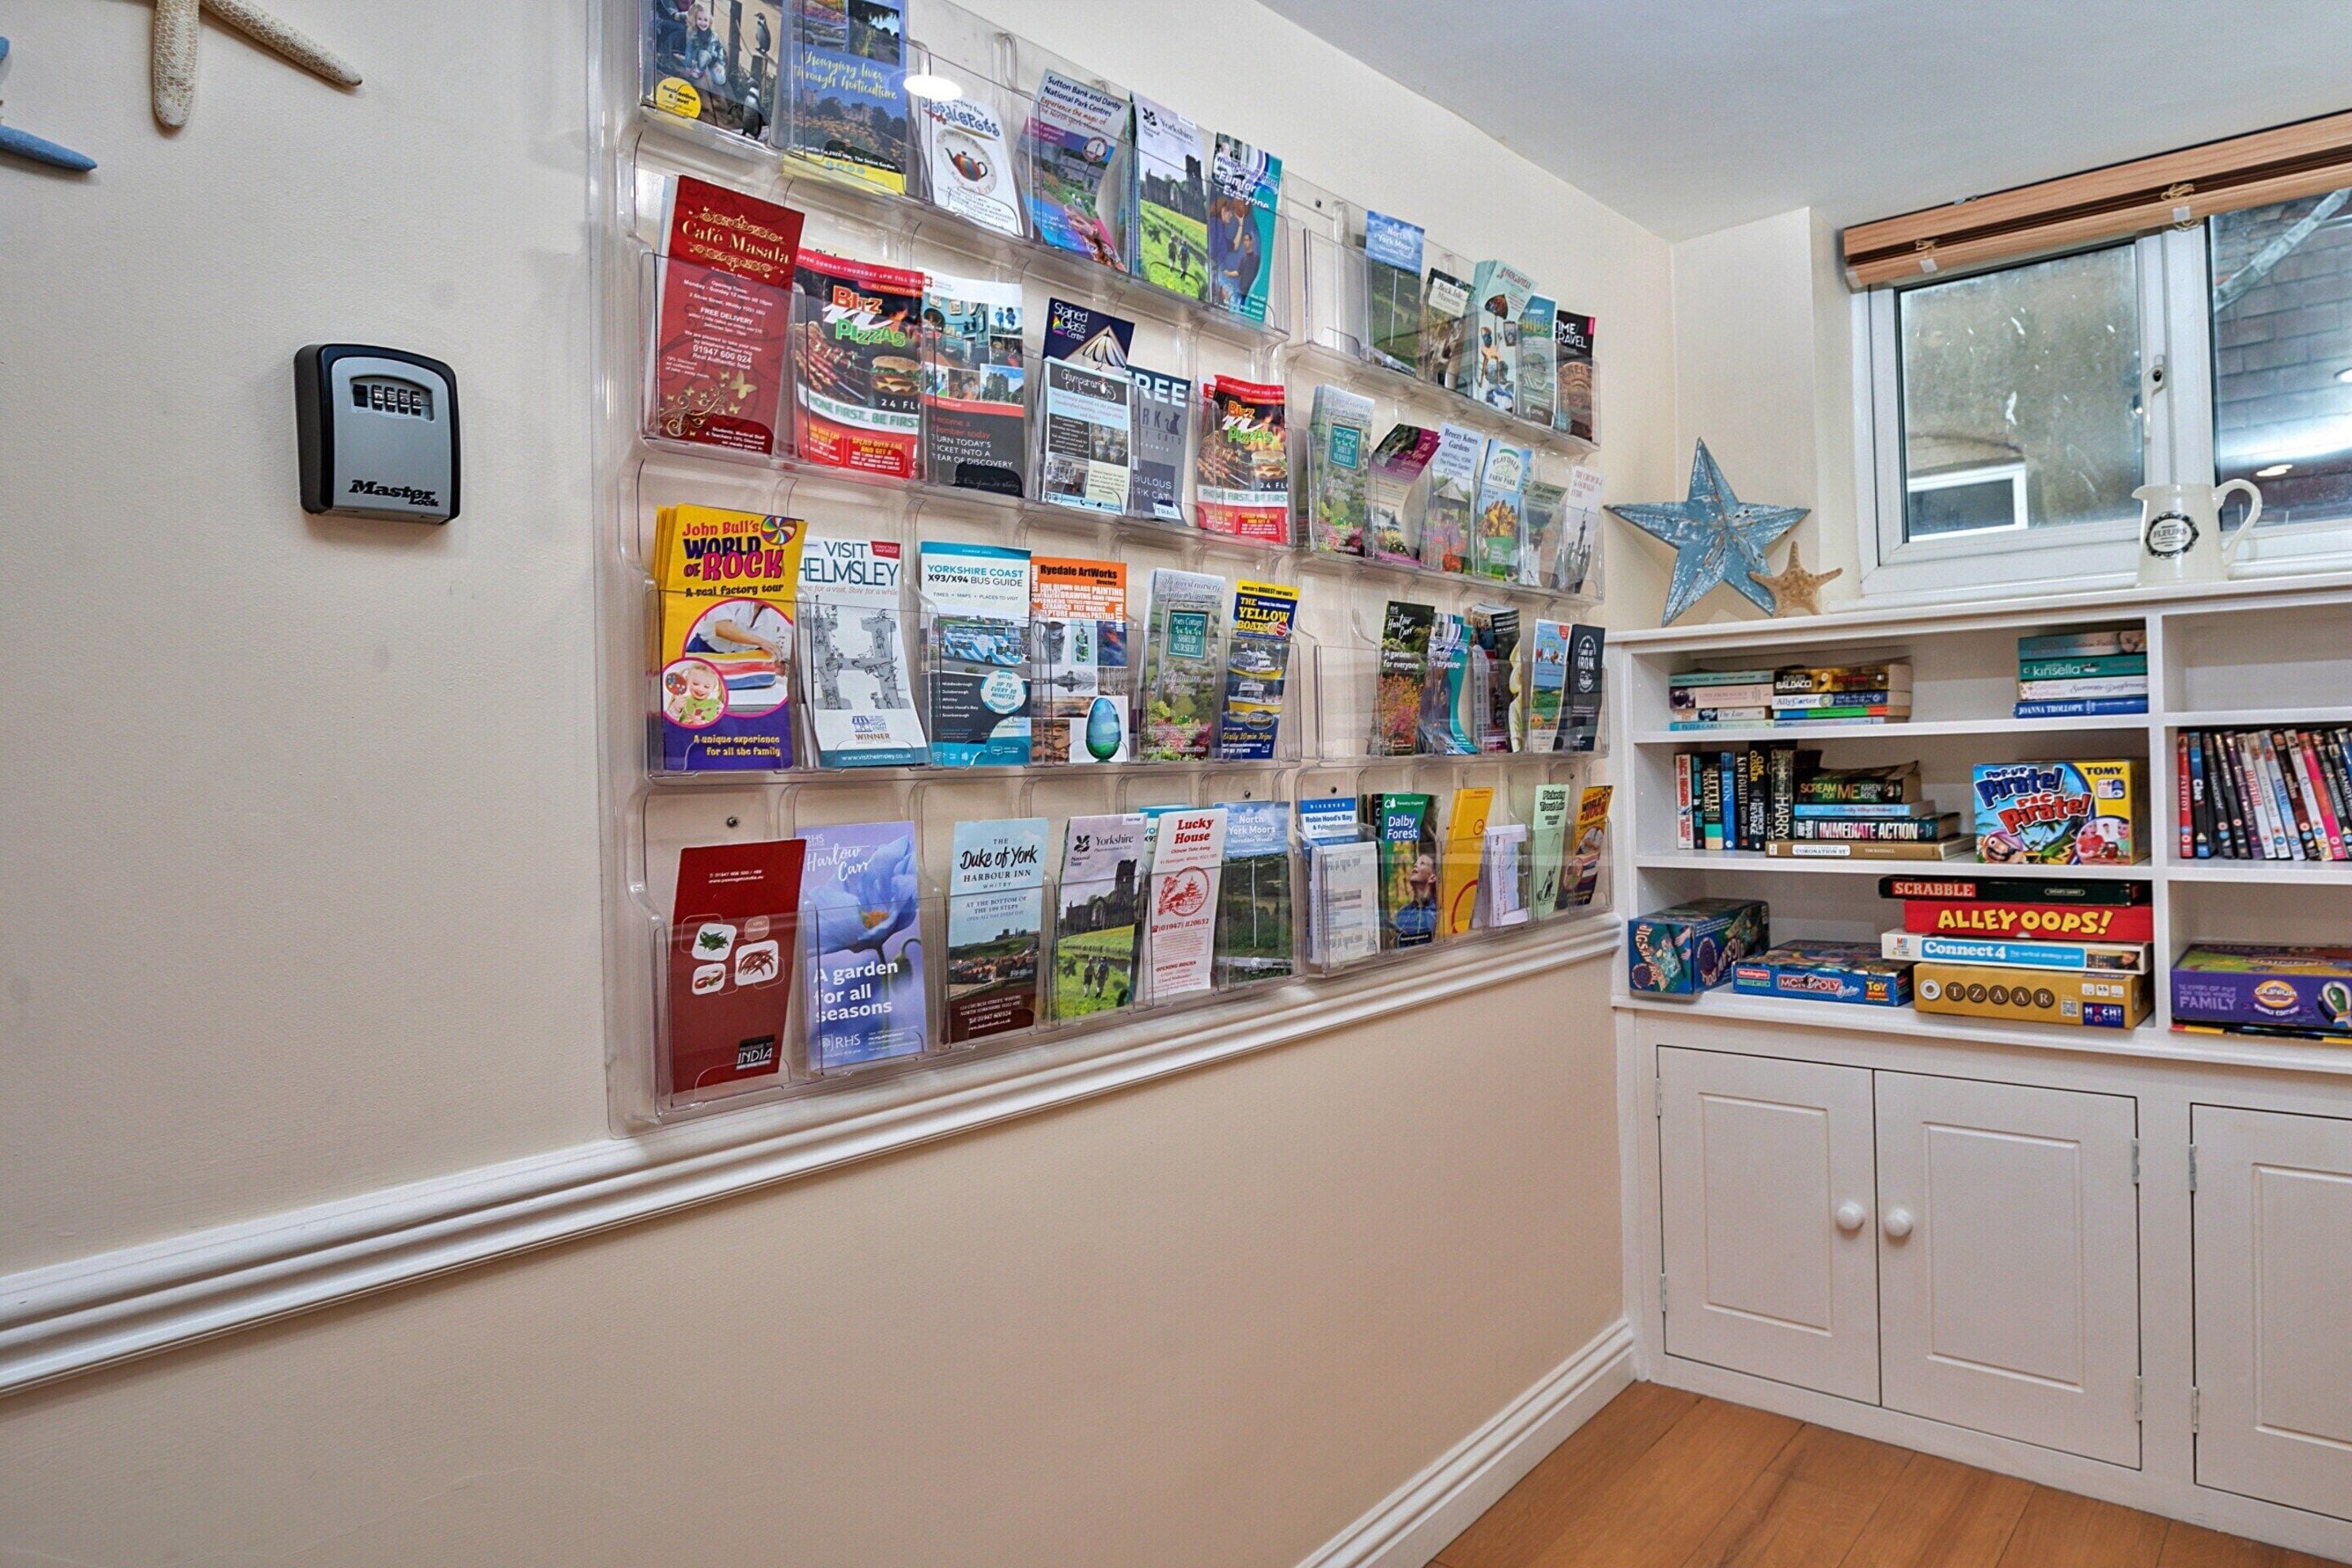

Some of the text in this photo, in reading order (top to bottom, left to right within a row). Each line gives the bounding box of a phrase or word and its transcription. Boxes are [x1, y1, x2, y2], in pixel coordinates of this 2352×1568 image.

[862, 63, 882, 82] lives
[841, 76, 897, 99] horticulture
[1048, 76, 1122, 110] Sutton Bank and Danby
[1040, 96, 1071, 113] Experience
[1044, 87, 1111, 117] National Park Centres
[1160, 118, 1194, 142] Yorkshire
[1219, 171, 1238, 185] Fun
[1241, 178, 1256, 193] for
[1223, 185, 1269, 209] Everyone
[682, 220, 789, 265] Café Masala
[1378, 234, 1393, 245] York
[700, 307, 719, 317] FREE
[719, 312, 753, 325] DELIVERY
[1054, 302, 1088, 323] Stained
[1061, 316, 1086, 334] Glass
[1067, 330, 1085, 341] Centre
[693, 345, 717, 356] 01947
[881, 399, 896, 408] 24
[871, 412, 887, 424] BE
[956, 439, 991, 448] TODAY'S
[1445, 428, 1477, 445] Breezy Knees
[1449, 440, 1470, 452] Gardens
[967, 458, 1013, 468] DISCOVERY
[1489, 474, 1516, 486] FARM PARK
[349, 479, 435, 500] Master
[409, 497, 439, 507] Lock
[682, 519, 759, 537] John Bull's
[683, 536, 761, 559] WORLD
[824, 541, 868, 559] VISIT
[702, 549, 784, 581] ROCK
[927, 564, 1024, 578] YORKSHIRE COAST
[1040, 564, 1117, 579] Ryedale ArtWorks
[928, 574, 1022, 587] X93/X94 BUS GUIDE
[685, 584, 784, 597] A factory tour
[1062, 591, 1091, 600] DRAWING
[1092, 586, 1124, 596] PAINTING
[1241, 597, 1257, 605] THE
[1239, 606, 1290, 622] YELLOW
[1237, 620, 1267, 632] BOATS
[1178, 635, 1196, 644] SHRUB
[1174, 643, 1198, 653] NURSERY
[1391, 651, 1410, 659] garden
[1383, 660, 1419, 670] for everyone
[2034, 664, 2080, 676] kinsella
[2019, 703, 2082, 715] JOANNA TROLLOPE
[702, 735, 731, 745] unique
[733, 736, 780, 745] experience
[706, 747, 781, 757] for all the family
[1985, 767, 2028, 778] POP-UP
[2085, 767, 2123, 775] TOMY
[1736, 757, 1748, 804] KEN FOLLETT
[1976, 767, 2065, 808] Pirate!
[1708, 774, 1719, 812] LITTLE
[1800, 783, 1837, 793] SCREAM
[1838, 784, 1860, 799] ME
[1860, 784, 1881, 792] KAREN
[2180, 775, 2189, 811] PATRIOT
[2193, 779, 2204, 800] Clue
[1860, 791, 1876, 800] ROSE
[2016, 794, 2053, 808] PIC
[1238, 815, 1264, 824] North
[1775, 796, 1789, 839] HARRY
[1998, 793, 2092, 835] Pirate!
[1177, 818, 1214, 830] Lucky
[1229, 825, 1276, 835] York Moors
[1388, 817, 1415, 829] Dalby
[1174, 832, 1210, 844] House
[1387, 828, 1418, 840] Forest
[1820, 822, 1918, 840] IMMEDIATE ACTION
[806, 834, 824, 844] RHS
[1096, 834, 1134, 846] Yorkshire
[807, 843, 862, 872] Harlow
[960, 845, 1038, 870] Duke of York
[838, 860, 871, 882] Carr
[964, 869, 1031, 883] HARBOUR INN
[1894, 881, 1974, 897] SCRABBLE
[991, 898, 1017, 906] BOTTOM
[1938, 909, 2114, 935] ALLEY OOPS!
[1924, 942, 1993, 958] Connect
[1994, 946, 2007, 960] 4
[813, 962, 898, 985] A garden
[1867, 981, 1886, 990] TOY
[814, 983, 871, 1005] for all
[2180, 996, 2236, 1010] FAMILY
[2254, 1004, 2300, 1016] FAMILY EDITION
[815, 1001, 893, 1022] seasons
[835, 1034, 861, 1048] RHS
[737, 1048, 772, 1064] INDIA
